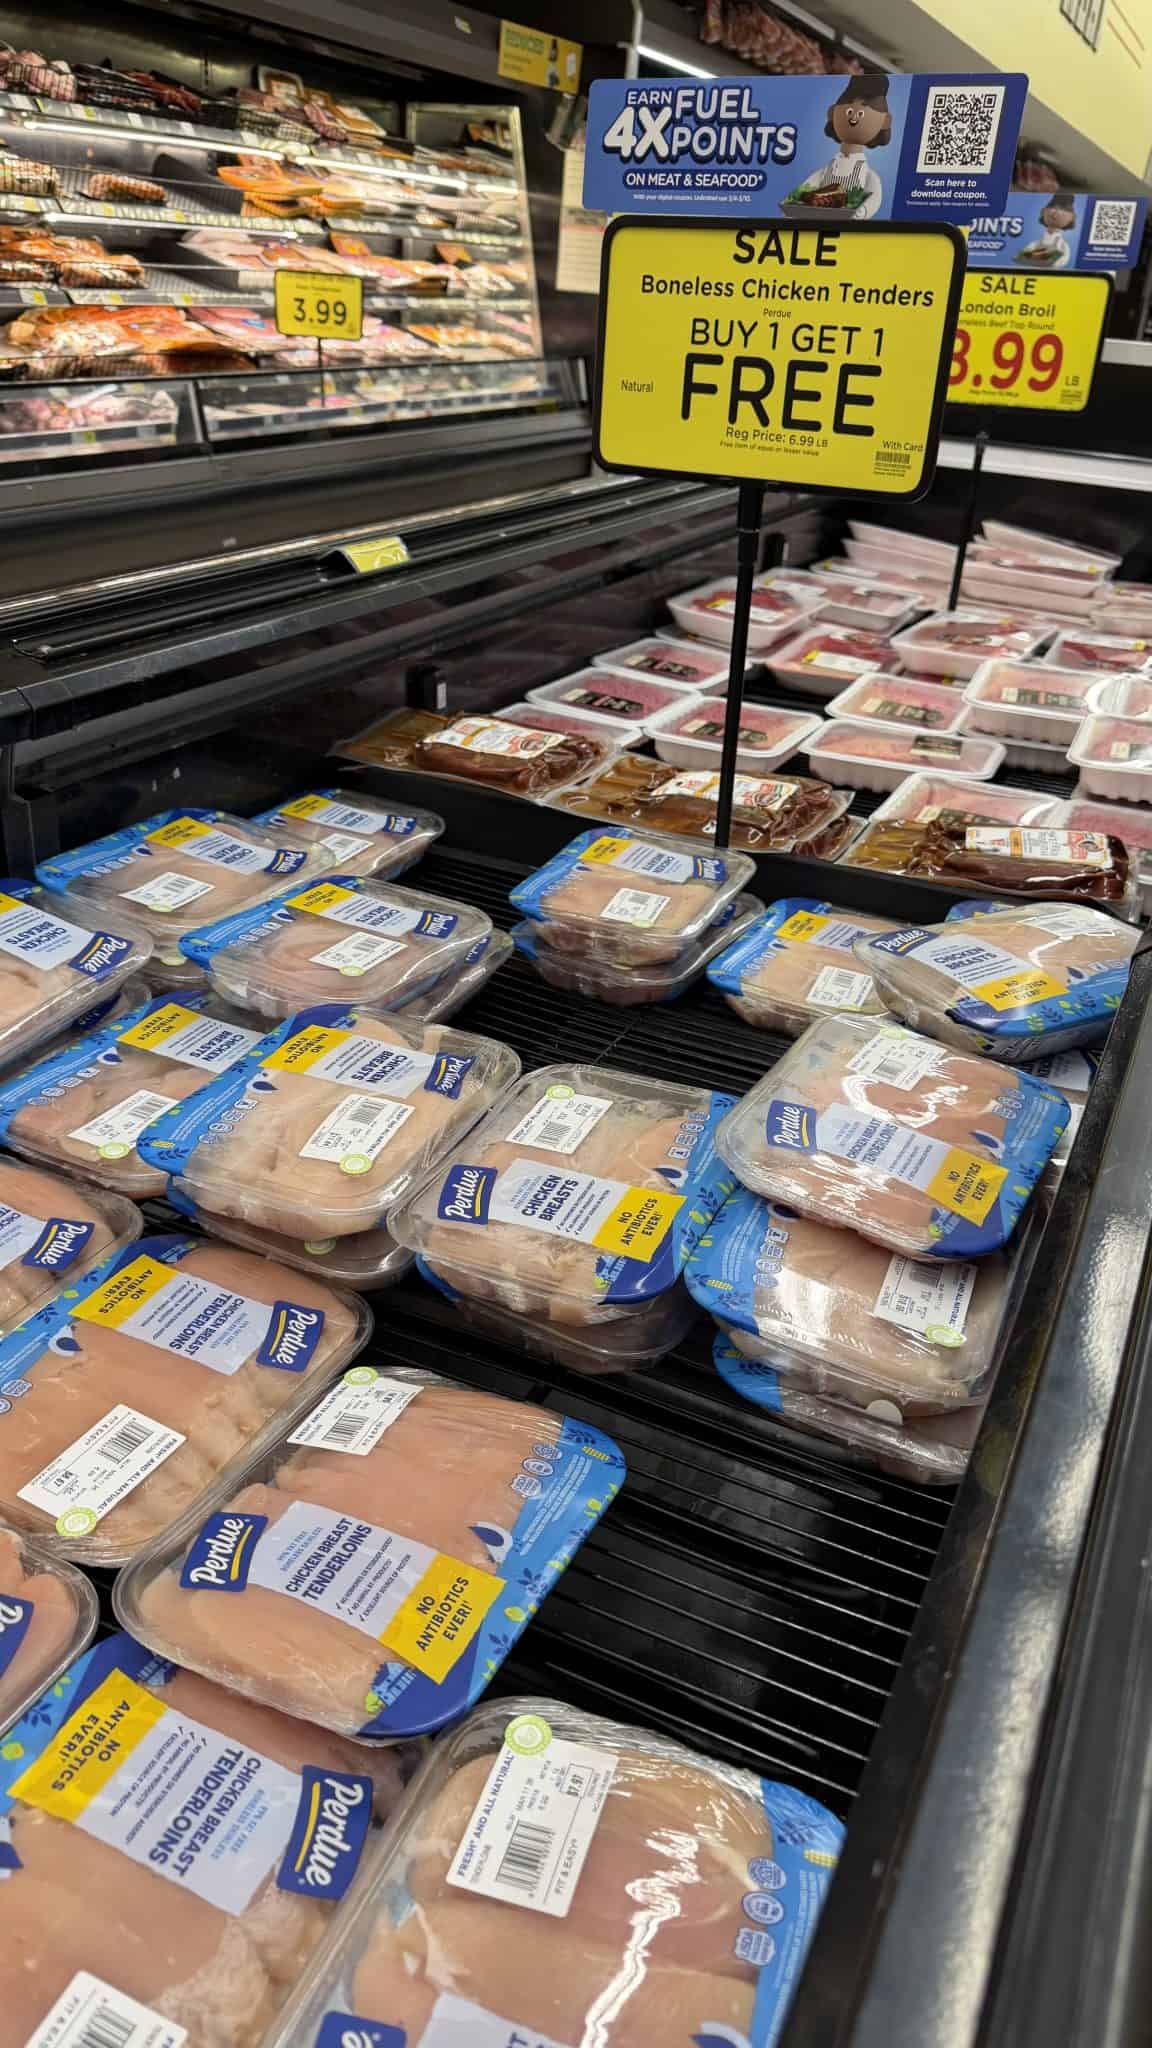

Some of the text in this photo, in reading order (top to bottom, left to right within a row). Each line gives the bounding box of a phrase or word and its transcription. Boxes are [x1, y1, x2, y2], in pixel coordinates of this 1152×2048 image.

[627, 88, 759, 119] EARN FUEL
[603, 106, 796, 158] 4X POINTS
[626, 173, 645, 186] ON
[648, 173, 681, 187] MEAT
[683, 174, 693, 187] &
[911, 189, 988, 200] download coupon.
[925, 178, 977, 187] Scan here to
[732, 228, 841, 267] SALE
[641, 274, 934, 307] Boneless Chicken Tenders
[980, 275, 1038, 296] SALE
[293, 297, 347, 326] 3.99
[763, 307, 791, 319] Perdue
[1019, 303, 1056, 318] Broil
[691, 317, 885, 357] BUY 1 GET 1
[620, 379, 654, 393] Natural
[681, 352, 883, 437] FREE
[1065, 375, 1080, 387] LB
[726, 428, 828, 448] Reg Price: 6.99 LB
[882, 439, 924, 452] With Card
[5, 920, 55, 945] BREASTS
[18, 927, 67, 951] CHICKEN
[877, 928, 926, 952] Perdue
[83, 936, 128, 973] Perdue
[934, 947, 986, 964] CHICKEN
[945, 952, 998, 970] BREASTS
[189, 1030, 233, 1057] BREASTS
[201, 1034, 245, 1062] CHICKEN
[284, 1032, 329, 1063] ANTIBIOTICS
[311, 1045, 325, 1054] NO
[351, 1050, 393, 1081] BREASTS
[366, 1054, 407, 1084] CHICKEN
[773, 1105, 801, 1147] Perdue
[862, 1123, 899, 1166] TENDERLOINS
[948, 1170, 960, 1181] NO
[952, 1162, 982, 1204] ANTIBIOTICS
[444, 1168, 480, 1219] Perdue
[521, 1174, 562, 1217] CHICKEN
[538, 1179, 580, 1221] BREASTS
[617, 1211, 633, 1224] NO
[619, 1198, 658, 1246] ANTIBIOTICS
[41, 1223, 88, 1265] Perdue
[98, 1269, 153, 1314] ANTIBIOTICS
[132, 1288, 146, 1300] NO
[169, 1292, 233, 1350] TENDERLOINS
[213, 1298, 245, 1332] CHICKEN
[185, 1326, 219, 1356] BREAST
[276, 1308, 318, 1366] Perdue
[190, 1518, 245, 1585] Perdue
[286, 1518, 353, 1593] CHICKEN BREAST
[302, 1524, 372, 1601] TENDERLOINS
[416, 1595, 436, 1615] NO
[416, 1576, 470, 1652] ANTIBIOTICS
[51, 1700, 131, 1792] ANTIBIOTICS
[98, 1738, 121, 1762] NO
[148, 1747, 244, 1866] TENDERLOINS
[172, 1757, 262, 1877] CHICKEN BREAST
[473, 1816, 488, 1839] AND
[482, 1798, 497, 1816] ALL
[304, 1778, 364, 1887] Perdue
